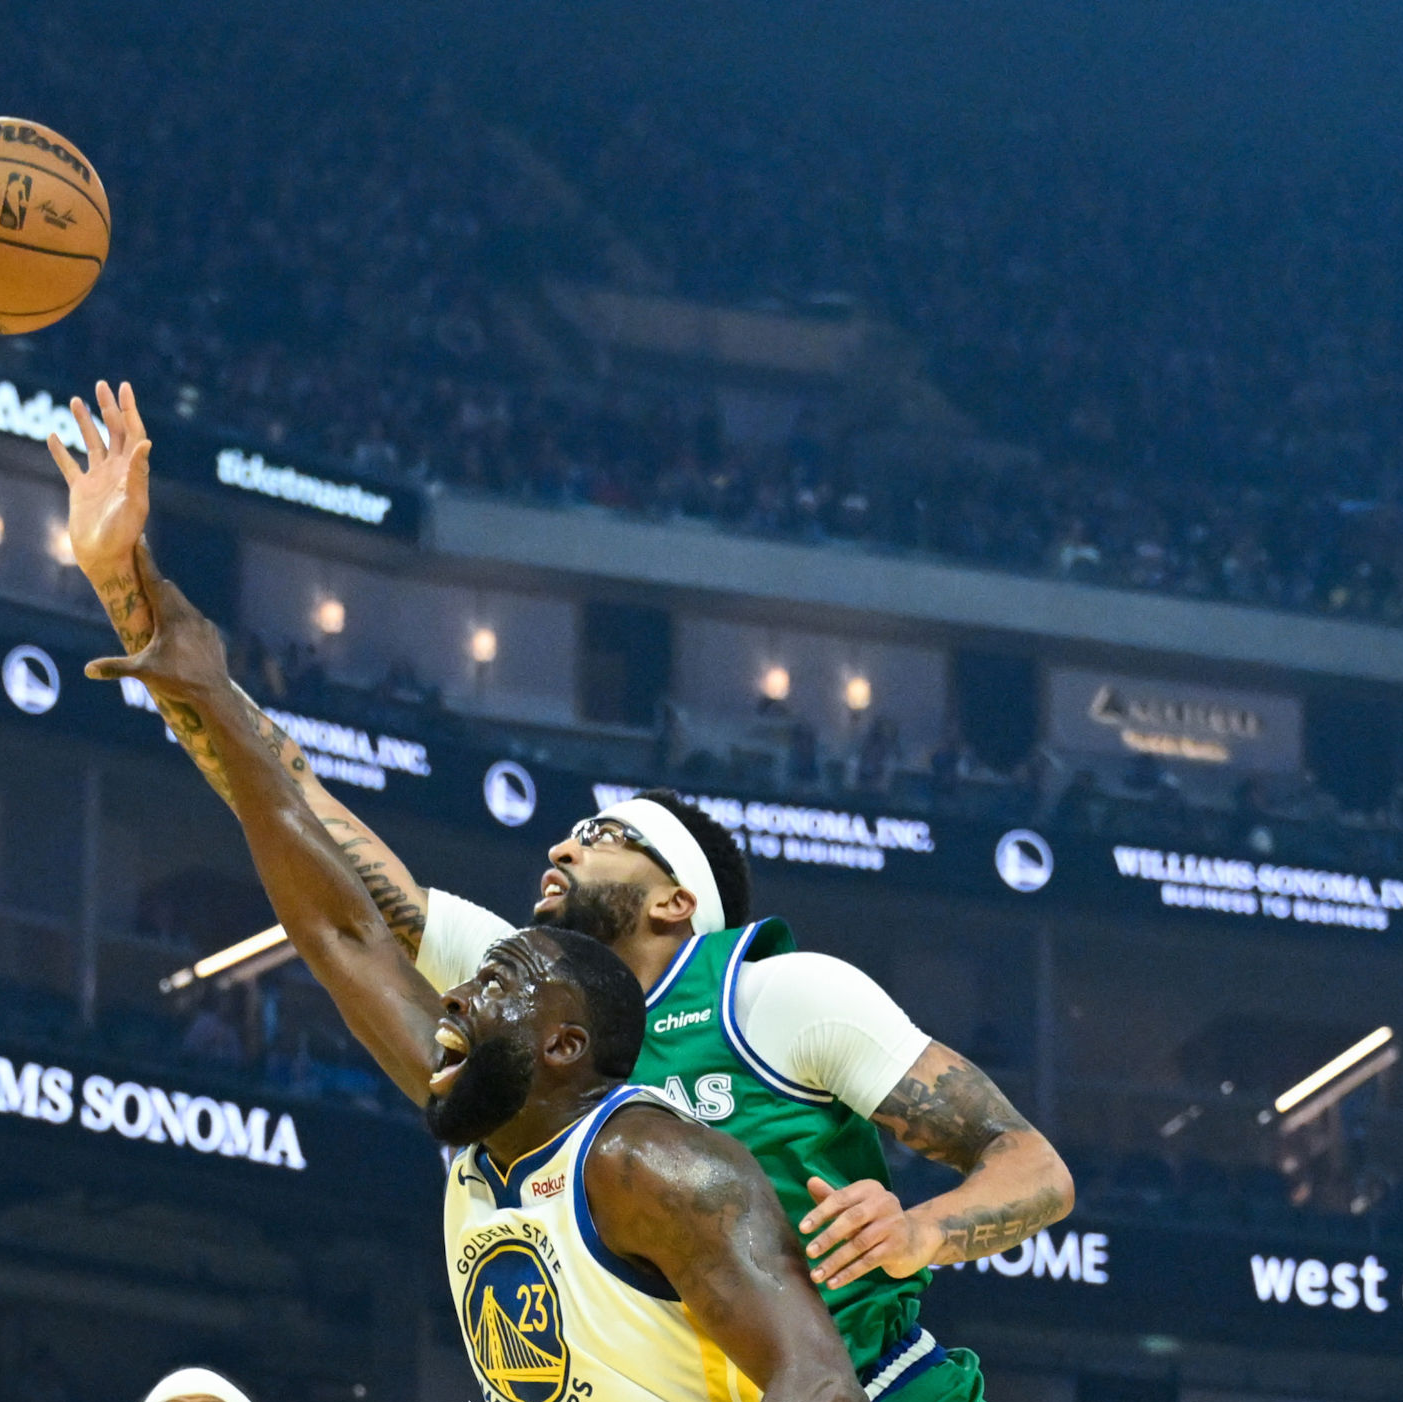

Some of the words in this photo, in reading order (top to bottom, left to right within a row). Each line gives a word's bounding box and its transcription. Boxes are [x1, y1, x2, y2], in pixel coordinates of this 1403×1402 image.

[216, 448, 392, 525] ticketmaster
[783, 838, 886, 872] BUSINESS
[1161, 882, 1259, 915] BUSINESS
[1260, 893, 1292, 919] TO
[1292, 899, 1390, 932] BUSINESS
[653, 1006, 713, 1034] chime
[81, 1074, 307, 1176] SONOMA
[456, 1223, 516, 1275] GOLDEN
[522, 1223, 562, 1274] STATE
[515, 1283, 548, 1333] 23
[1250, 1254, 1389, 1313] west
